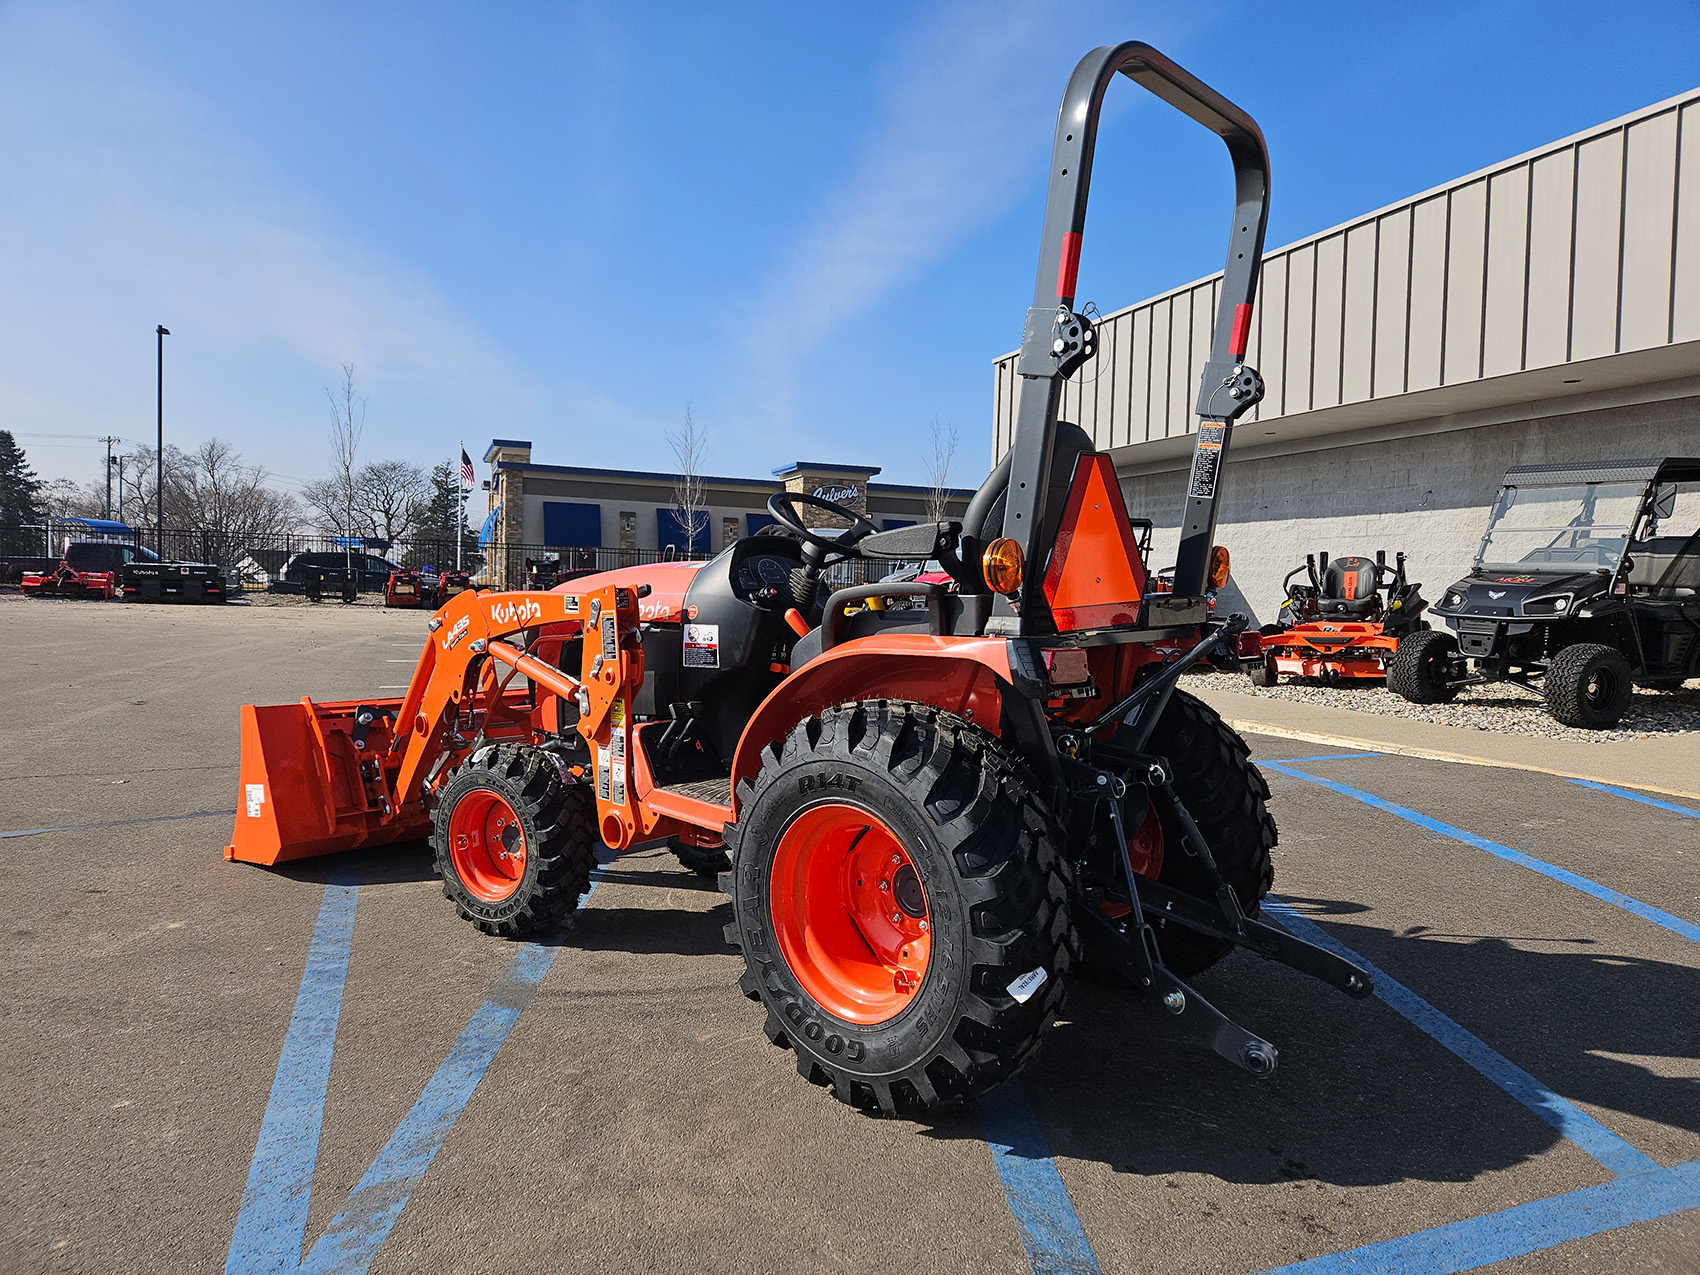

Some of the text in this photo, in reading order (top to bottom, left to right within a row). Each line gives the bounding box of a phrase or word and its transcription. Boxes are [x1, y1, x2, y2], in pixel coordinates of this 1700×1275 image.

[491, 597, 542, 624] Kubota
[441, 614, 470, 650] LA435
[798, 771, 863, 797] R14T
[740, 862, 867, 1065] GOODYEAR
